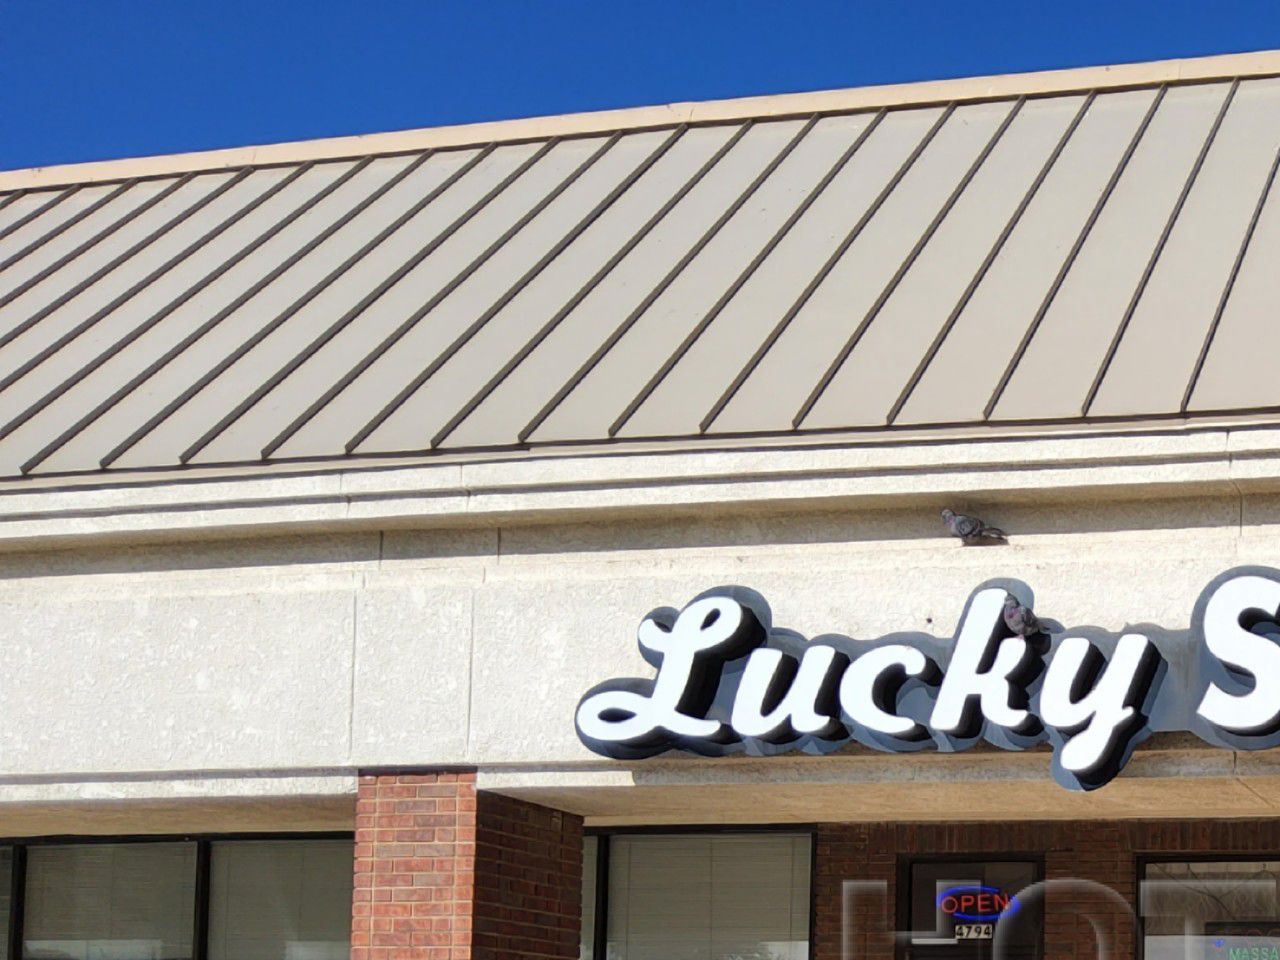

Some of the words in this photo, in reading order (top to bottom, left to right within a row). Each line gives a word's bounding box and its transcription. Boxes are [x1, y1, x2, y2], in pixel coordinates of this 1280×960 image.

[577, 586, 1147, 774] Lucky
[941, 893, 1009, 914] OPEN
[956, 925, 992, 938] 4794
